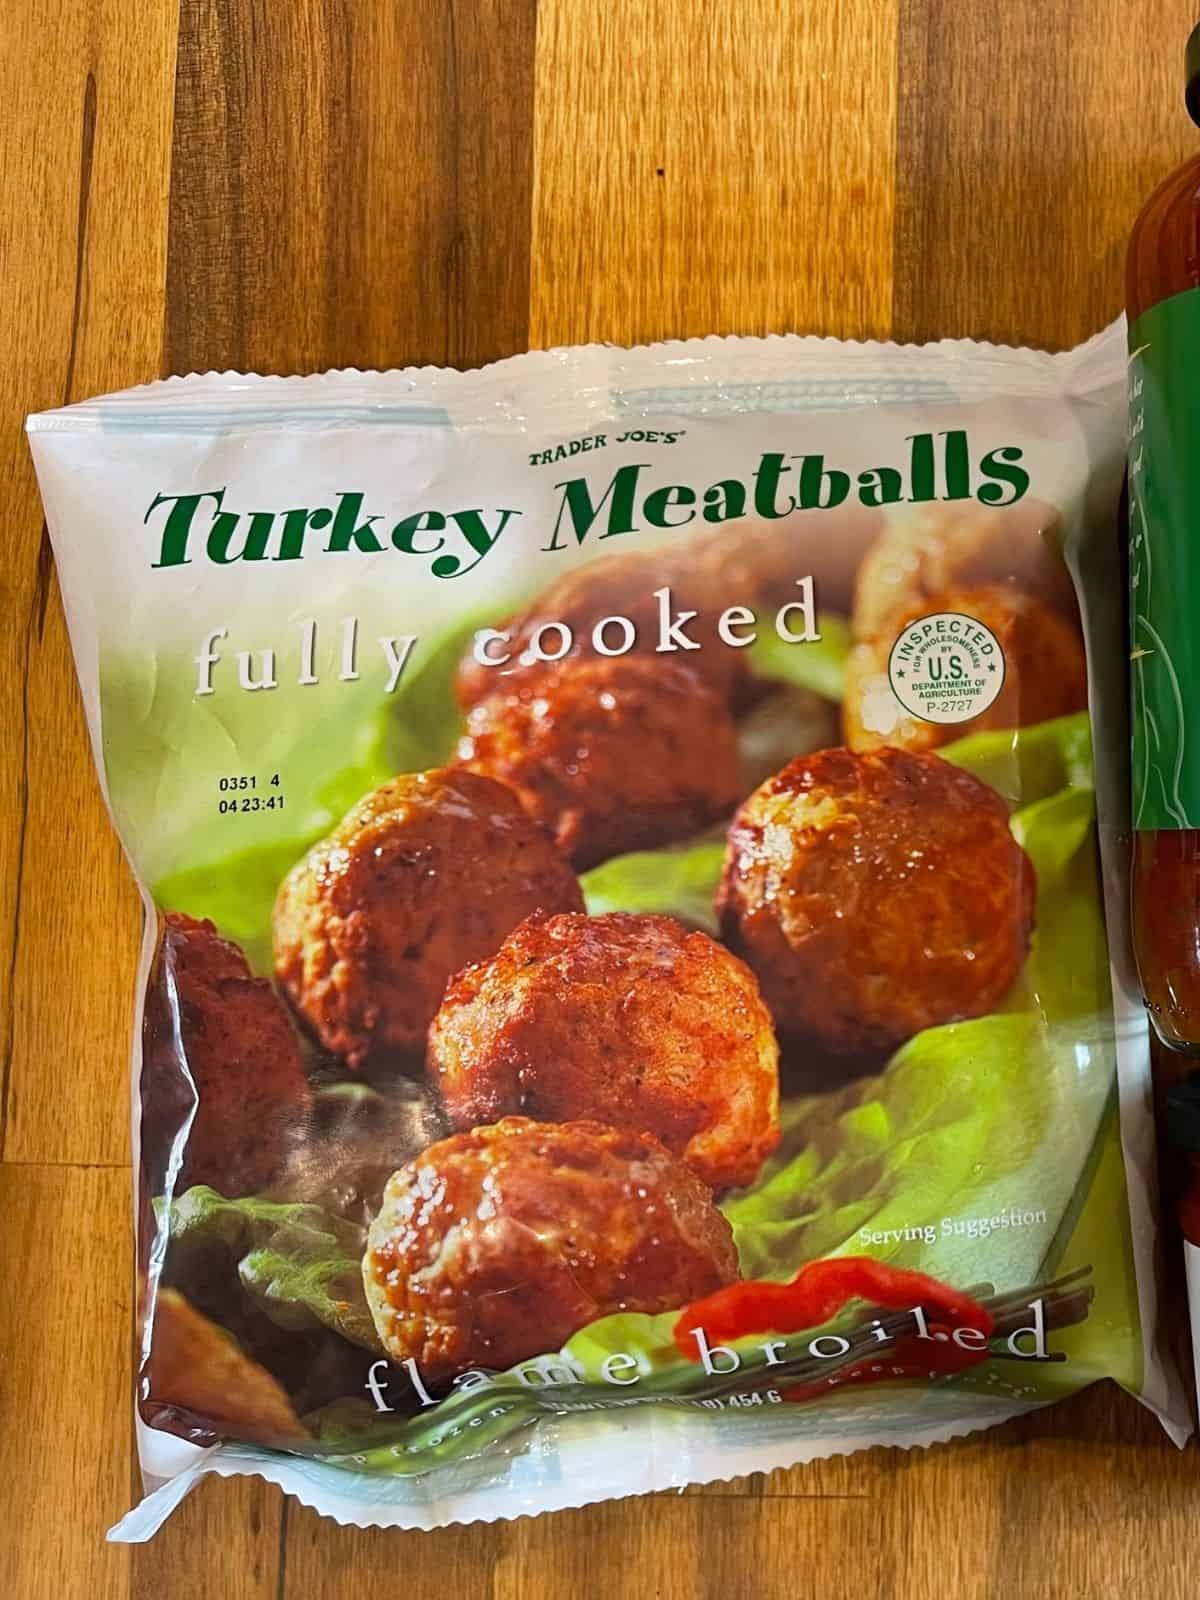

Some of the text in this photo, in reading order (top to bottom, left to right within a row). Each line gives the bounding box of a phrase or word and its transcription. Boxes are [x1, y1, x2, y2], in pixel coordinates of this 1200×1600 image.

[529, 430, 682, 465] TRADER JOE'S
[144, 486, 523, 579] Turkey
[540, 430, 1031, 552] Meatballs
[193, 576, 821, 695] fully cooked
[897, 620, 994, 661] INSPECTED
[928, 655, 968, 681] U.S.
[912, 679, 986, 691] DEPARTMENT OF
[919, 688, 982, 699] AGRICULTURE
[927, 699, 973, 712] P-2727
[219, 774, 280, 791] 0351 4
[242, 796, 285, 813] 23:41
[859, 1207, 1047, 1247] Serving Suggestion
[365, 1299, 1049, 1412] flame broiled
[729, 1391, 762, 1408] 454
[767, 1389, 783, 1404] G
